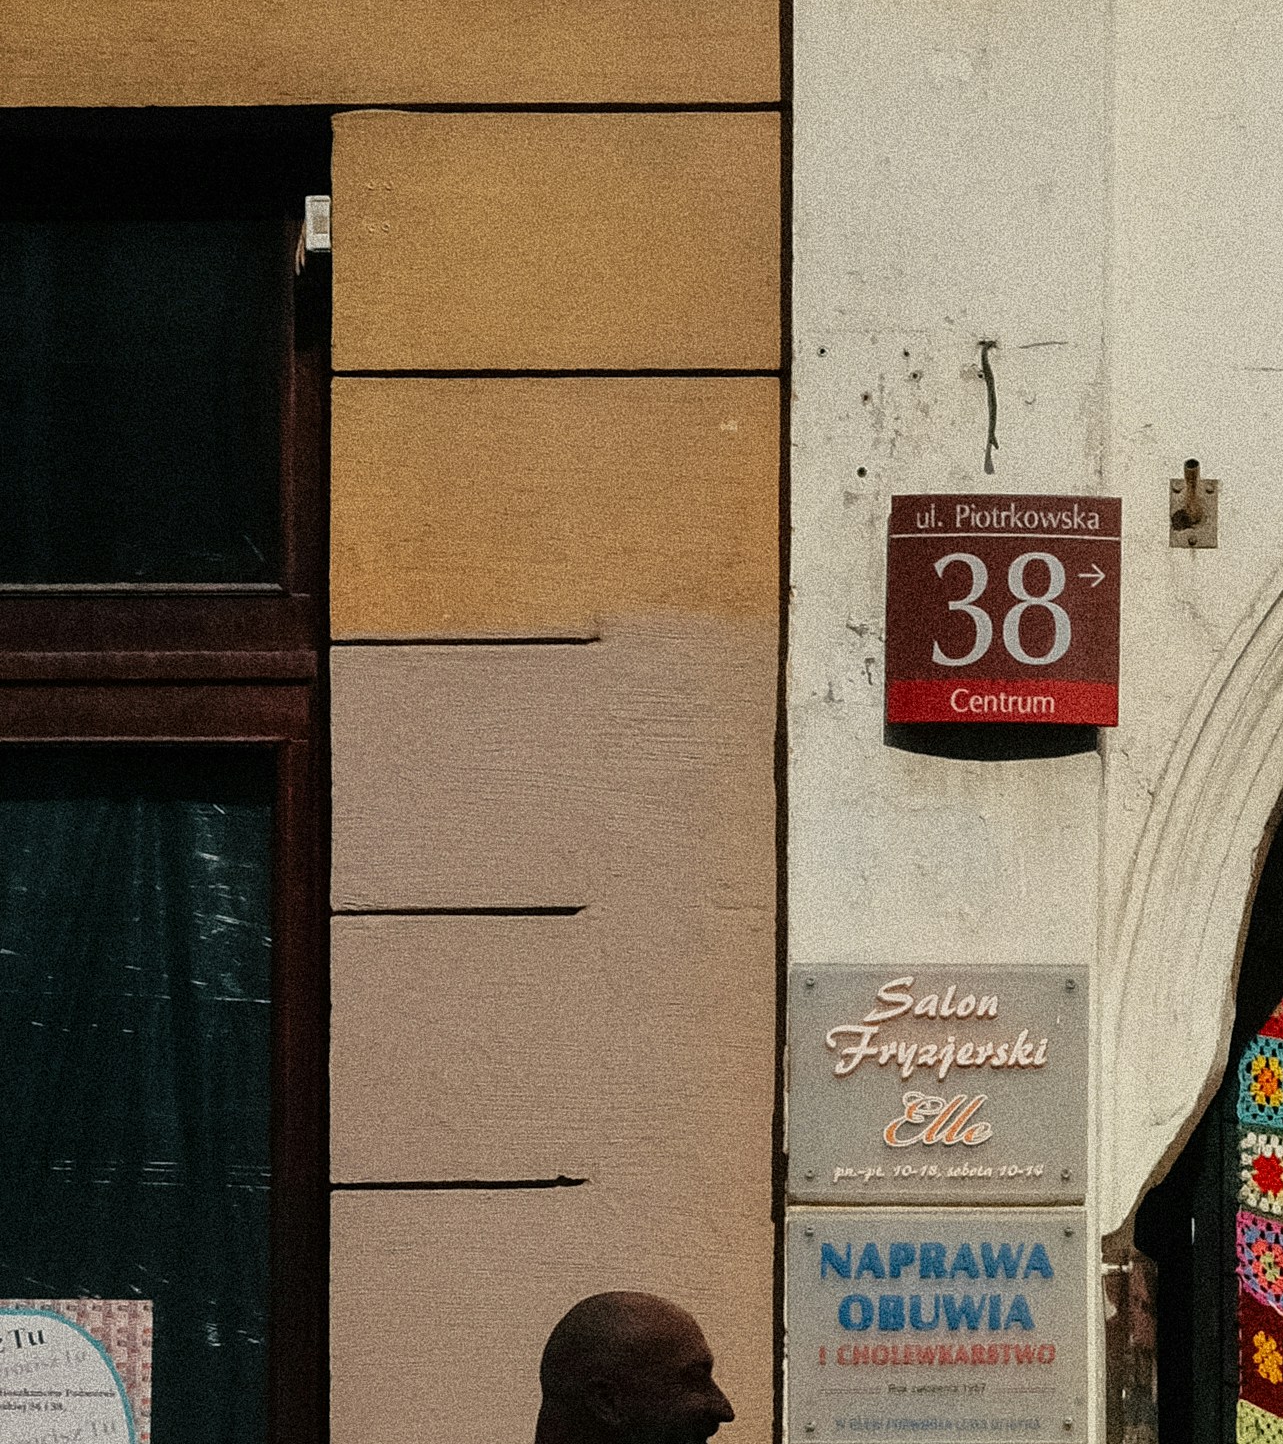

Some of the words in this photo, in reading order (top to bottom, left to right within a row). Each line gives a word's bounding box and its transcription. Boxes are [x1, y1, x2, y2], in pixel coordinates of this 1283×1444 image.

[916, 507, 944, 529] ul.
[955, 502, 1100, 532] Piotrkowska
[930, 551, 1073, 667] 38
[949, 688, 1056, 715] Centrum
[862, 975, 999, 1022] Salon
[825, 1023, 1050, 1083] Fryzjerski
[883, 1090, 994, 1147] Elle
[819, 1240, 1055, 1280] NAPRAWA
[837, 1293, 1037, 1333] OBUWIA
[8, 1327, 47, 1349] Tu
[835, 1343, 1058, 1368] CHOLEWKARSTWO
